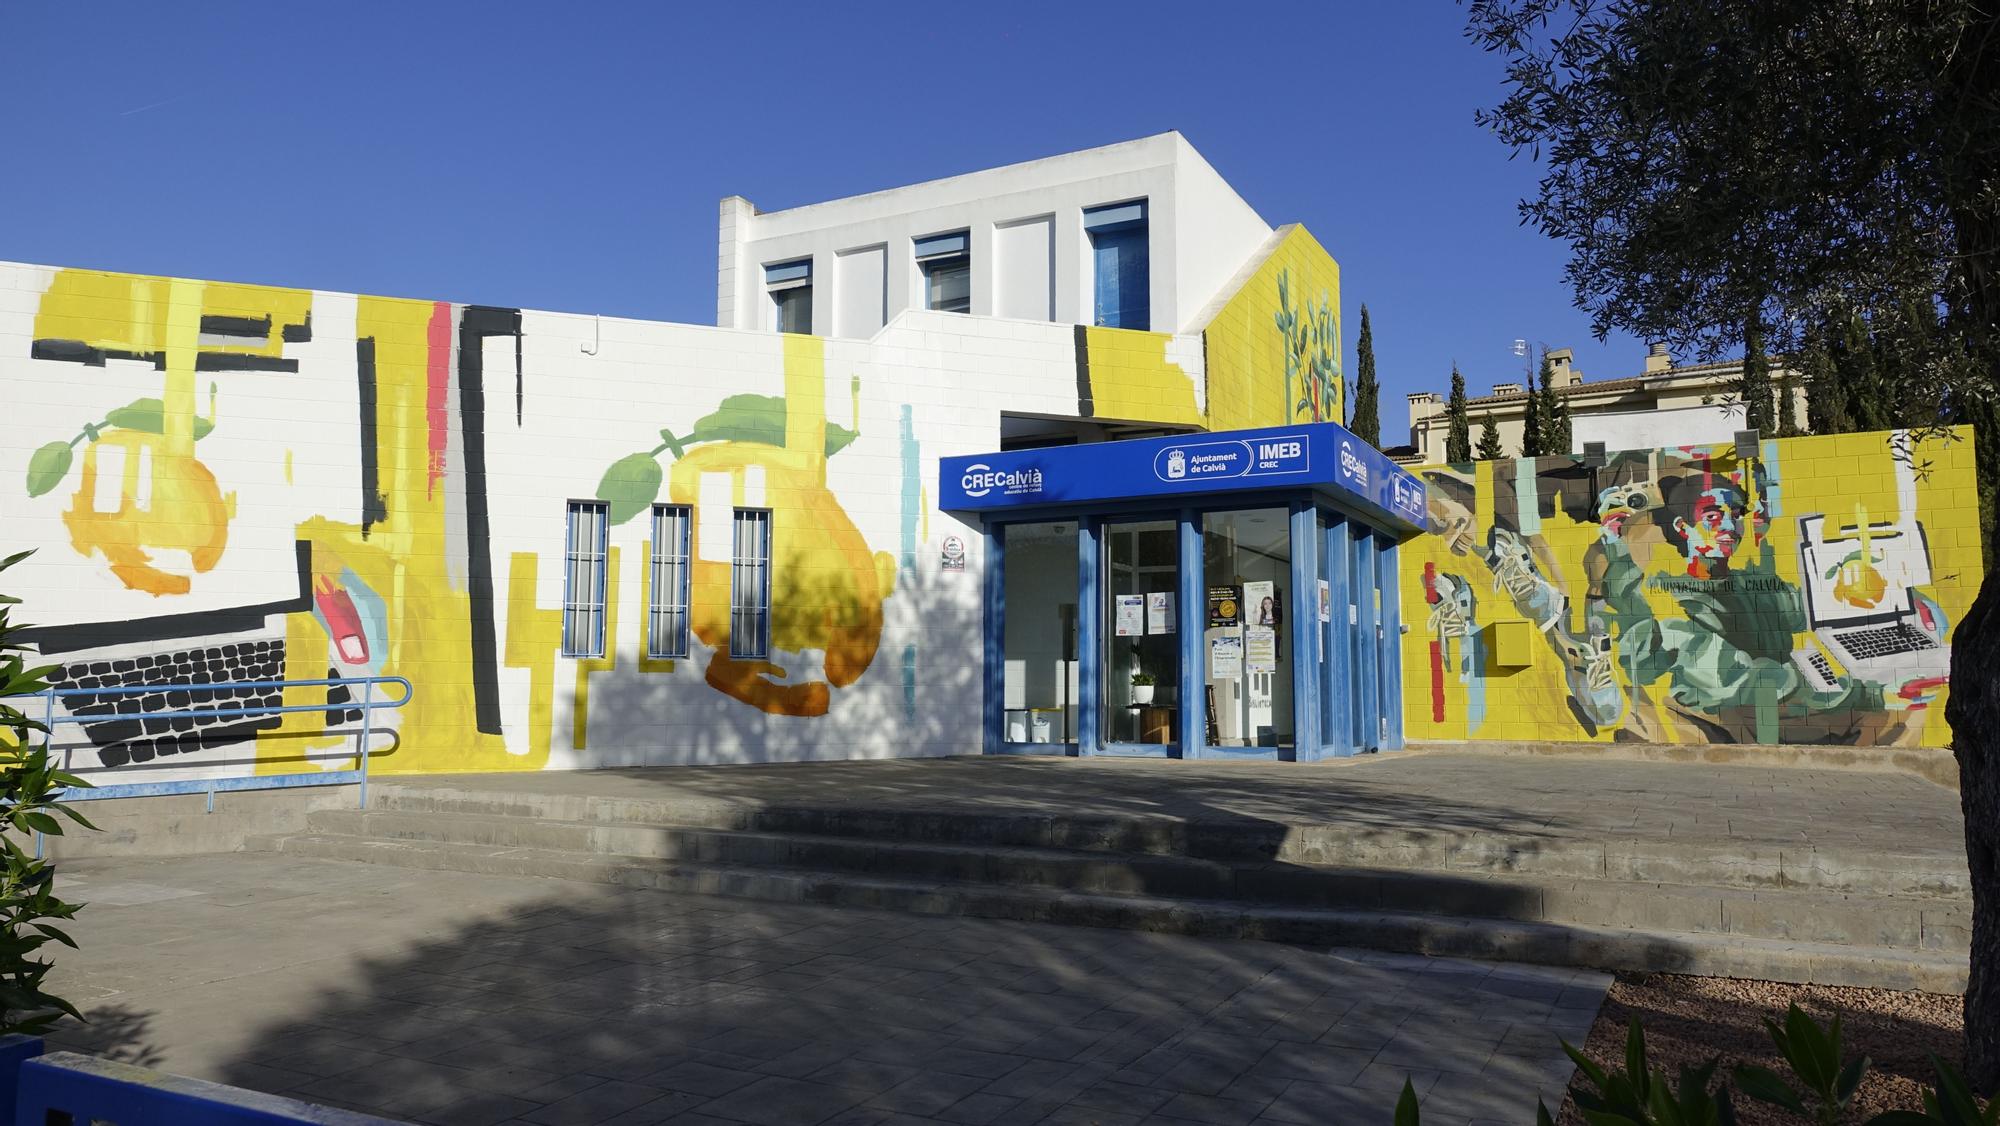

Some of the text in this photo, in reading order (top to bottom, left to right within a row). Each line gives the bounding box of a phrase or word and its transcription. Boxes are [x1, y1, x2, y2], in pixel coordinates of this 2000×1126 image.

[1259, 442, 1301, 460] IMEB
[1190, 452, 1238, 464] Ajuntament
[1191, 463, 1226, 473] de Calvià
[1259, 461, 1279, 469] CREC
[961, 468, 1043, 490] CRECalvià
[1724, 579, 1736, 592] DE
